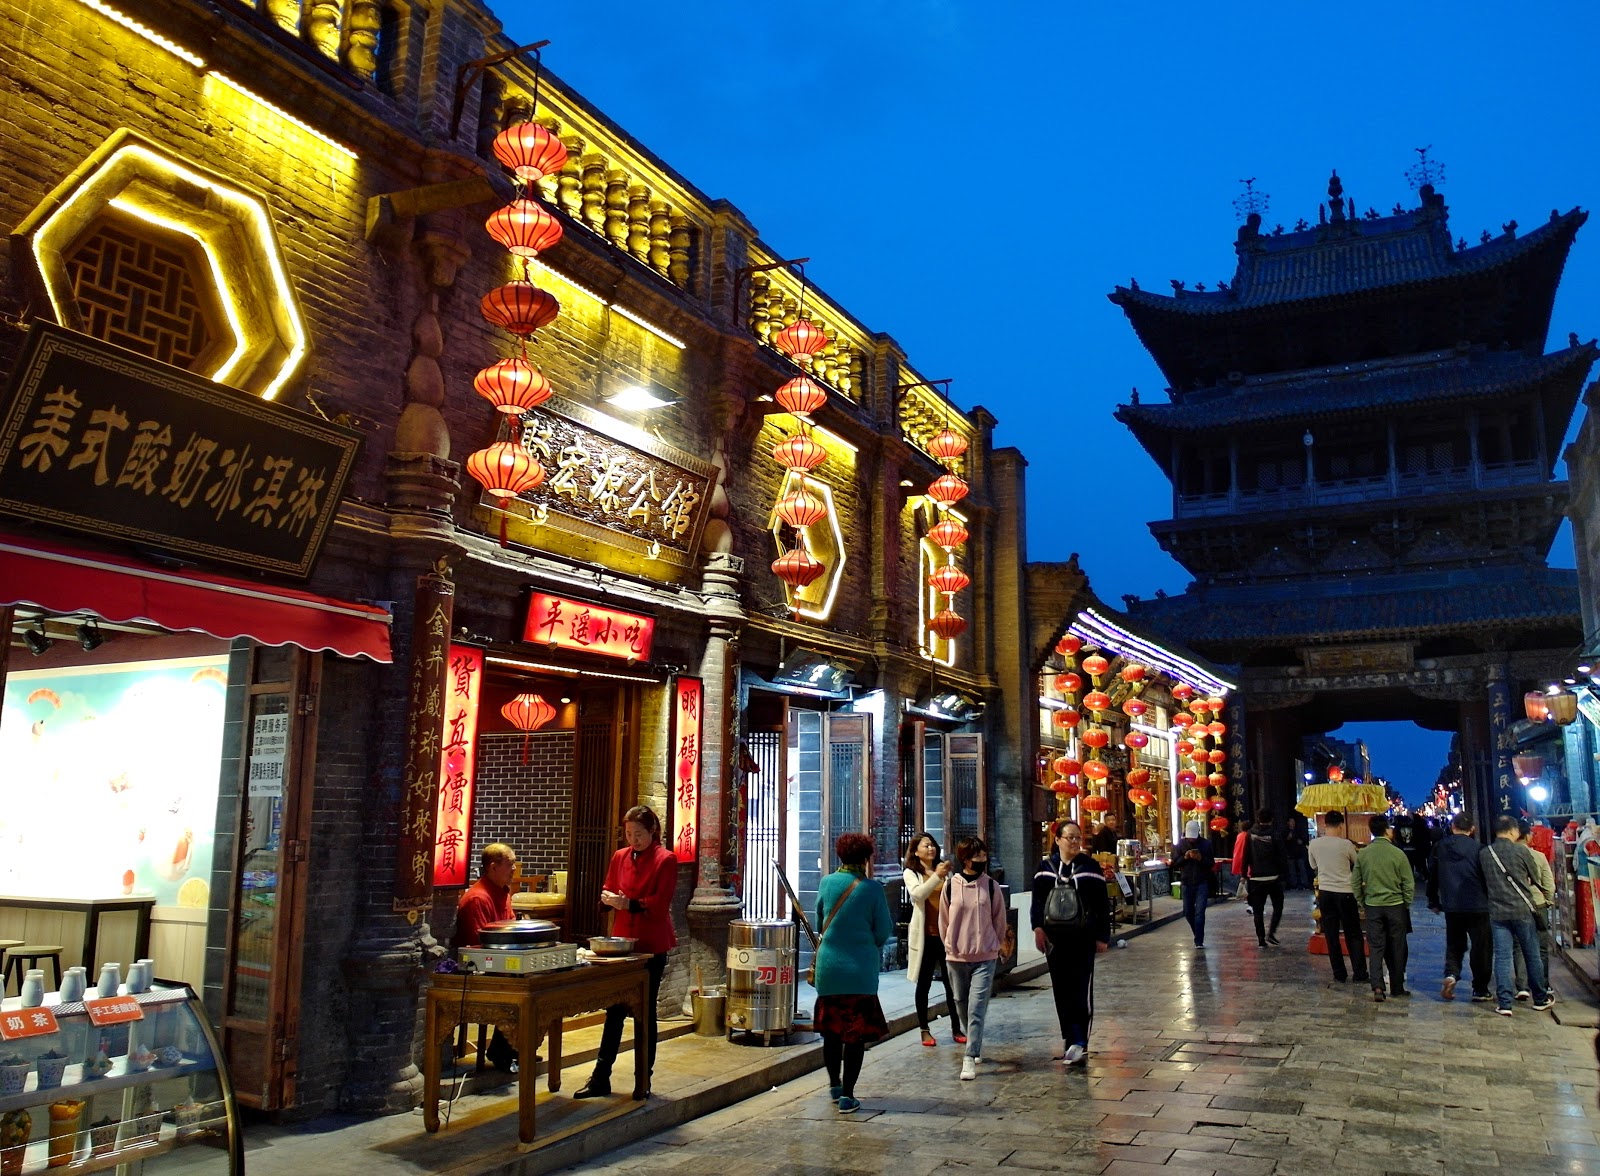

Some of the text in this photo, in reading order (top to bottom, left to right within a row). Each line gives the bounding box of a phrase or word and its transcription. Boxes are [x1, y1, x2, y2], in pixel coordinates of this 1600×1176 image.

[19, 384, 327, 538] 美式酸奶冰淇淋
[435, 655, 478, 875] 貨真價實
[677, 688, 698, 857] 明碼標價
[6, 1012, 50, 1031] 奶茶
[91, 1002, 139, 1017] 手工老酸奶
